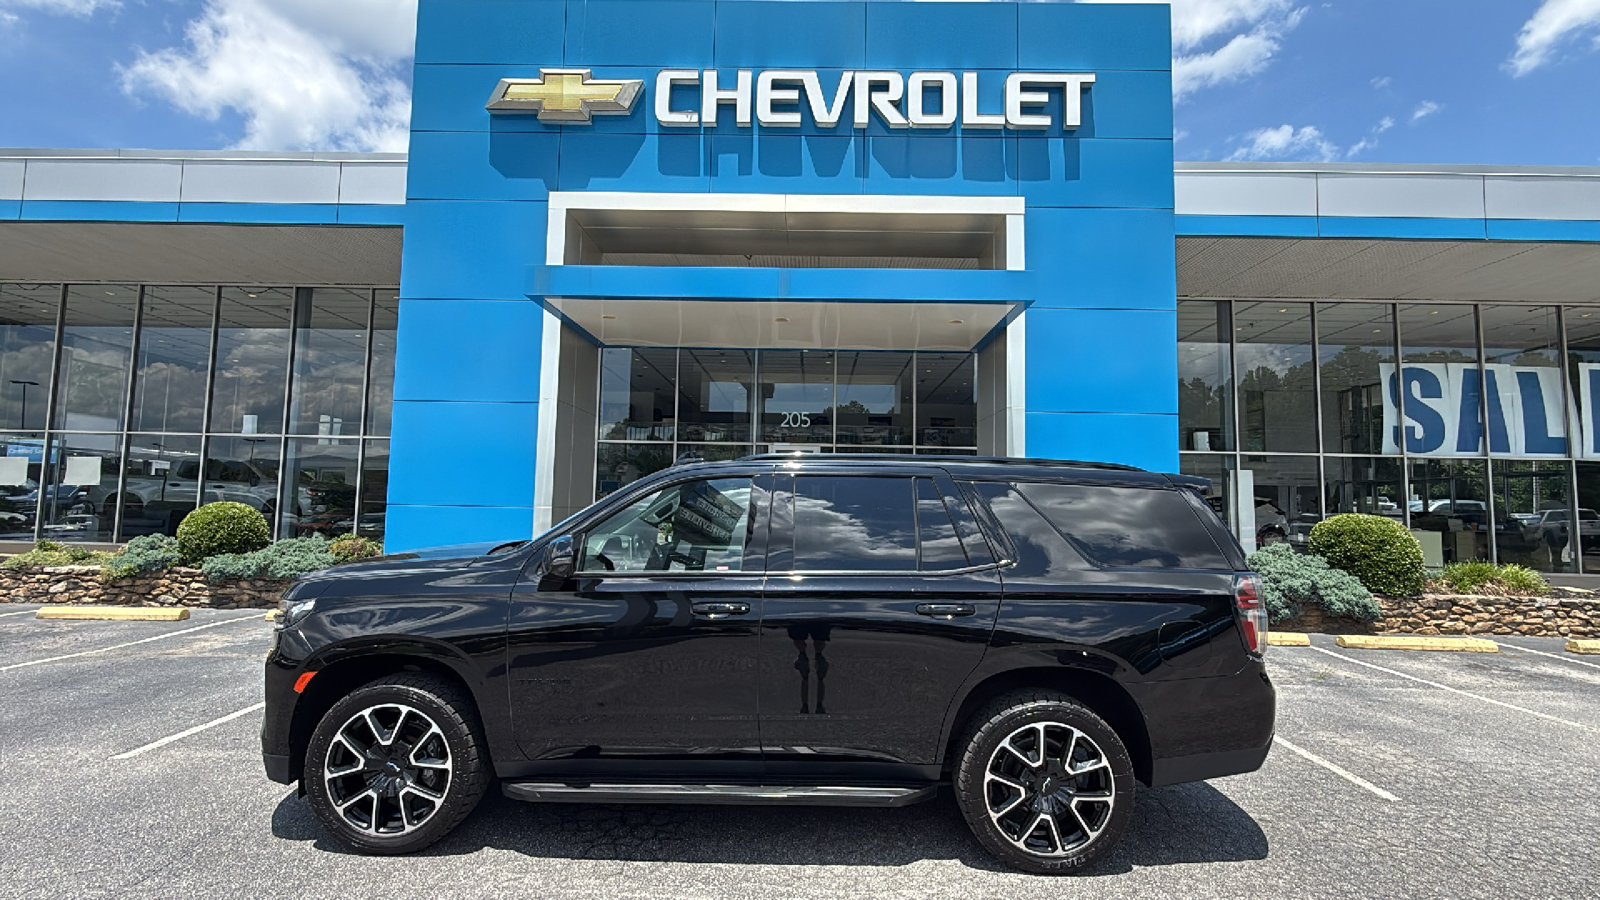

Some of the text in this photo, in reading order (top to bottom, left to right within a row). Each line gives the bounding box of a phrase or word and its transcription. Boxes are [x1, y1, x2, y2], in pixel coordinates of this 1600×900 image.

[655, 69, 1096, 129] CHEVROLET
[780, 411, 811, 428] 205
[1389, 367, 1600, 454] SAL
